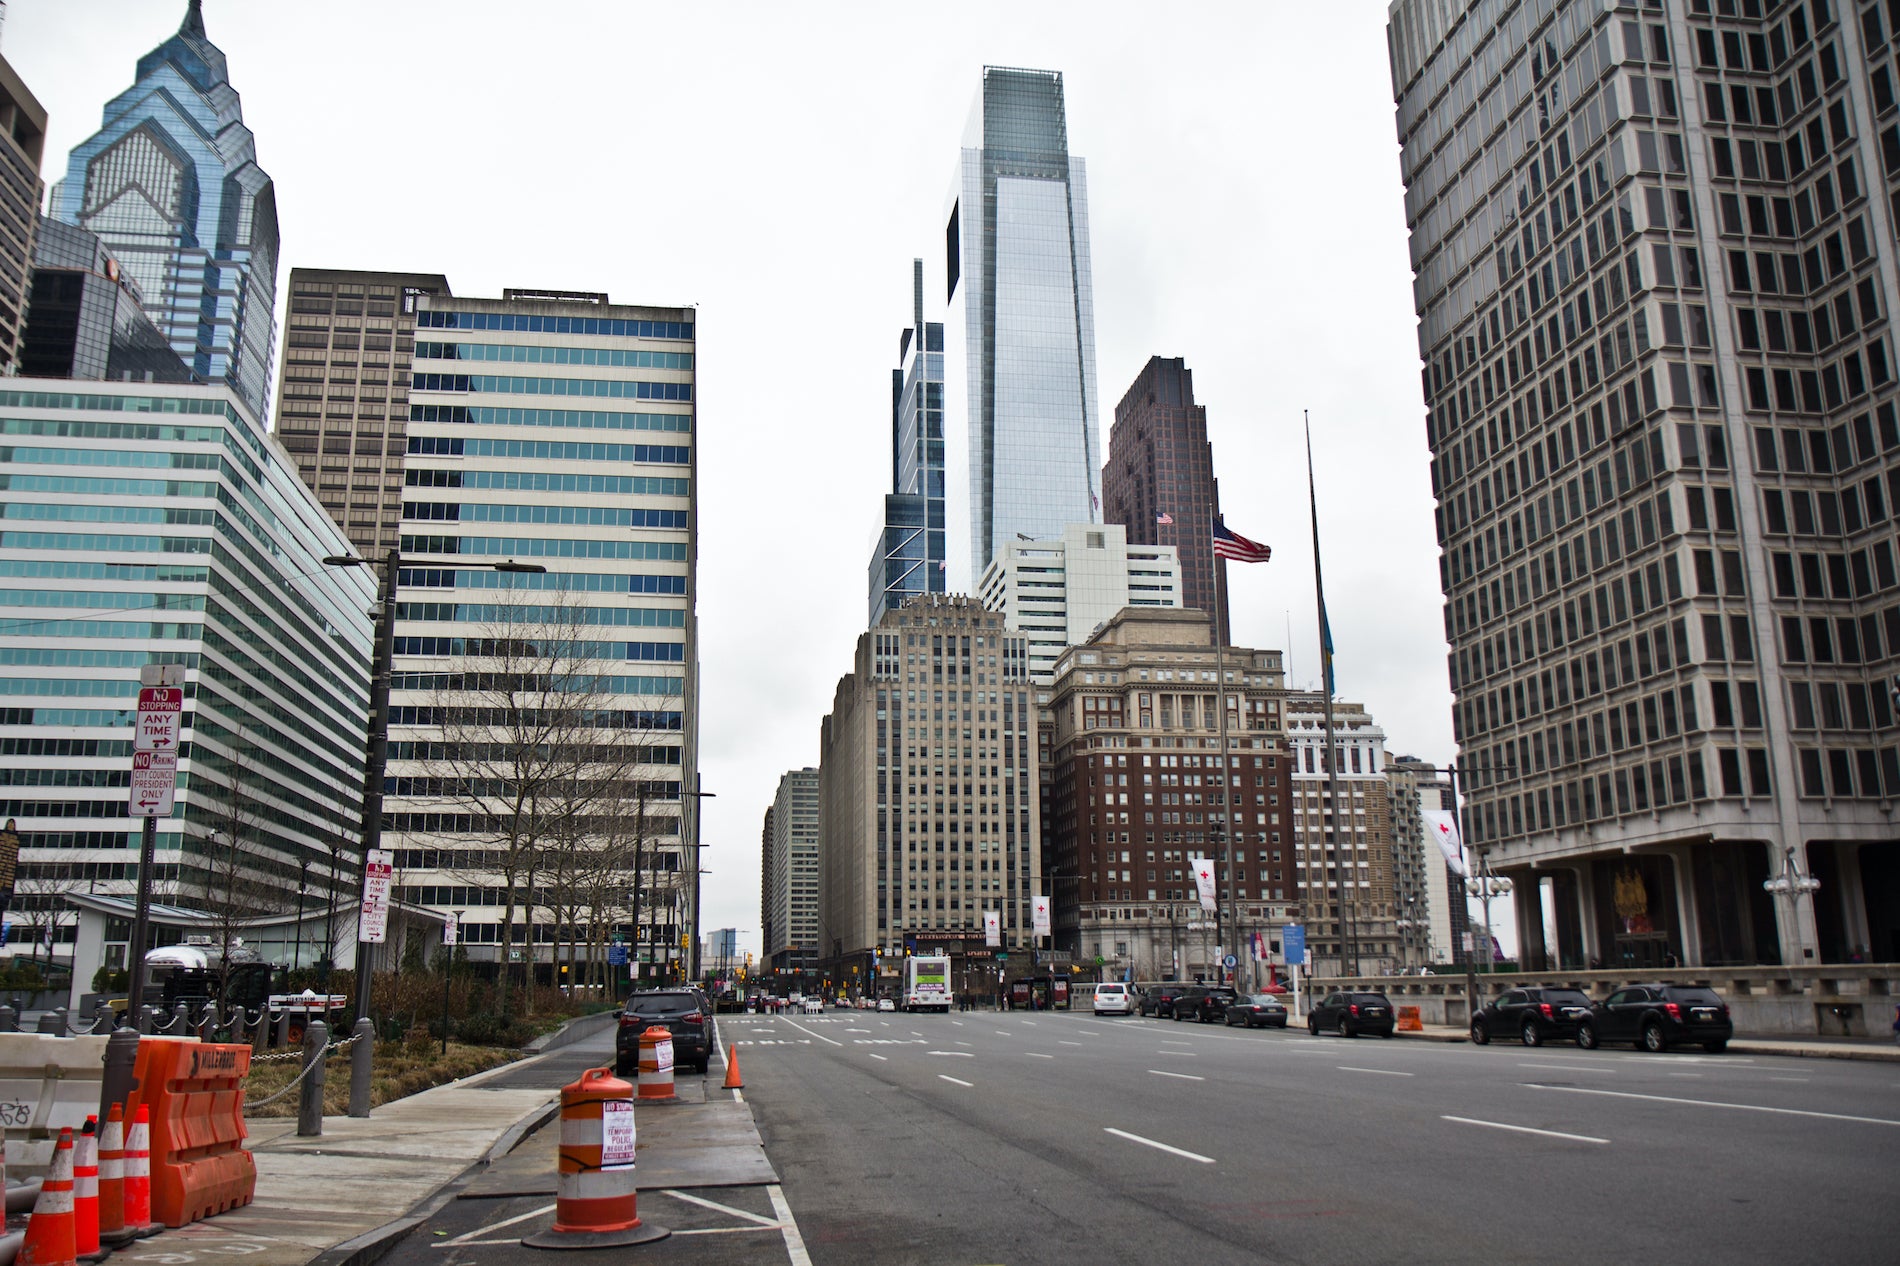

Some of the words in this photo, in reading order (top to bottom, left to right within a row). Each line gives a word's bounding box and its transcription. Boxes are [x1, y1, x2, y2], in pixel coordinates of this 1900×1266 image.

[152, 689, 169, 702] NO
[140, 701, 180, 711] STOPPING
[144, 714, 172, 724] ANY
[143, 726, 172, 736] TIME
[135, 753, 150, 768] NO
[135, 770, 148, 779] CITY
[149, 770, 173, 779] COUNCIL
[135, 780, 173, 789] PRESIDENT
[141, 789, 164, 799] ONLY
[374, 864, 385, 873] NO
[363, 903, 373, 912] NO
[363, 919, 385, 927] COUNCIL
[606, 1102, 615, 1111] NO
[611, 1136, 632, 1144] POLICE
